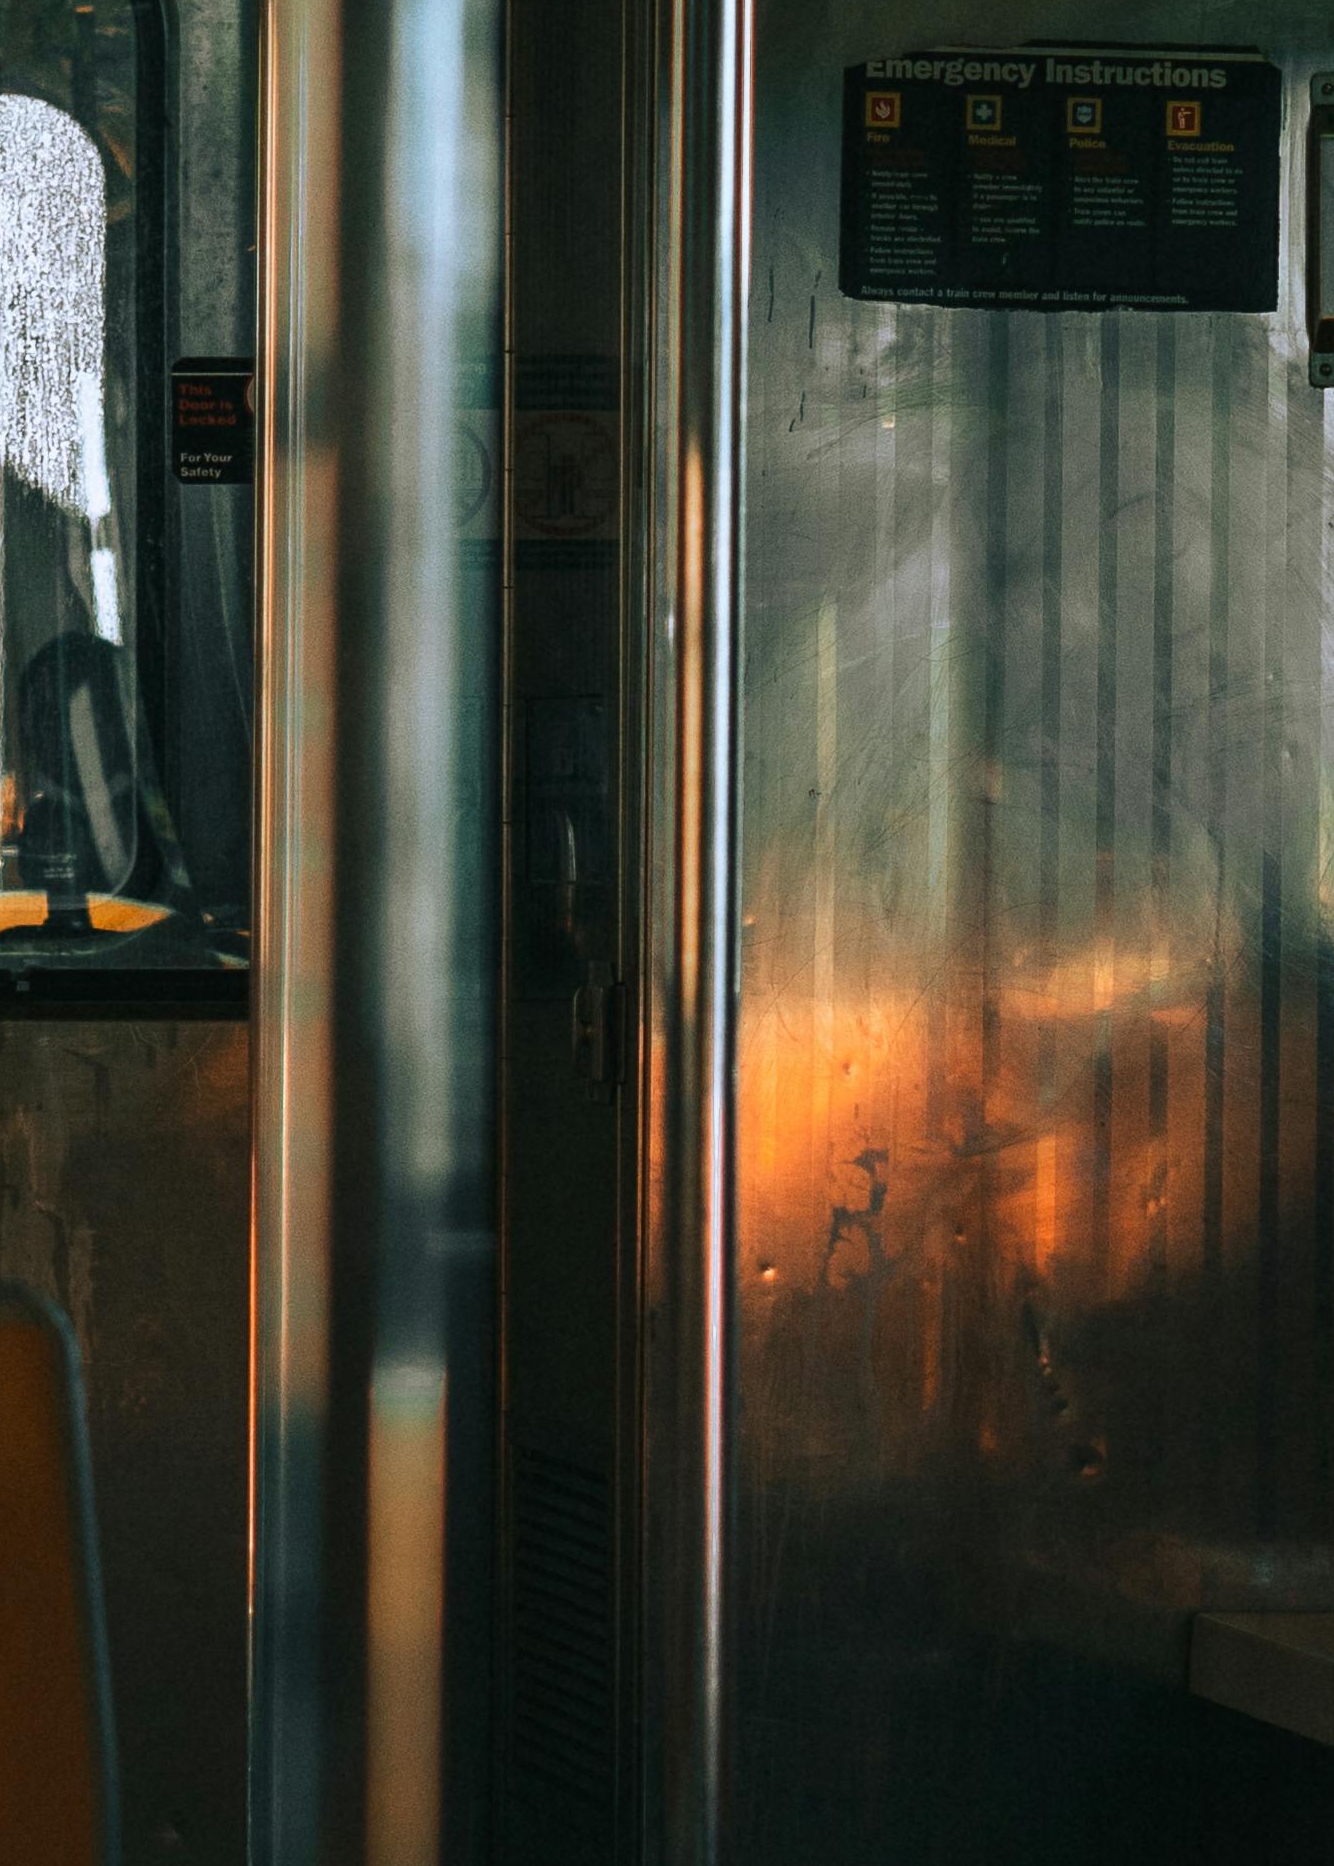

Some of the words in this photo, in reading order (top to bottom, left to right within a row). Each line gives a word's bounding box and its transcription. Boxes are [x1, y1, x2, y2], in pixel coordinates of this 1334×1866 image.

[866, 57, 1036, 88] Emergency
[1045, 58, 1227, 89] Instructions
[867, 133, 891, 144] Fire
[967, 134, 1017, 147] Medical
[1069, 138, 1107, 149] Police
[1167, 141, 1235, 152] Evacuation
[861, 285, 894, 297] Always
[897, 286, 934, 297] contact
[946, 288, 969, 298] train
[973, 291, 996, 299] crew
[999, 290, 1038, 300] member
[1042, 291, 1060, 301] and
[1063, 291, 1089, 301] listen
[1092, 292, 1107, 302] for
[1110, 293, 1189, 304] announcements.
[179, 383, 212, 396] This
[178, 399, 215, 411] Door
[178, 414, 236, 426] Locked
[180, 453, 204, 462] For
[204, 453, 233, 463] Your
[180, 467, 222, 480] Safety
